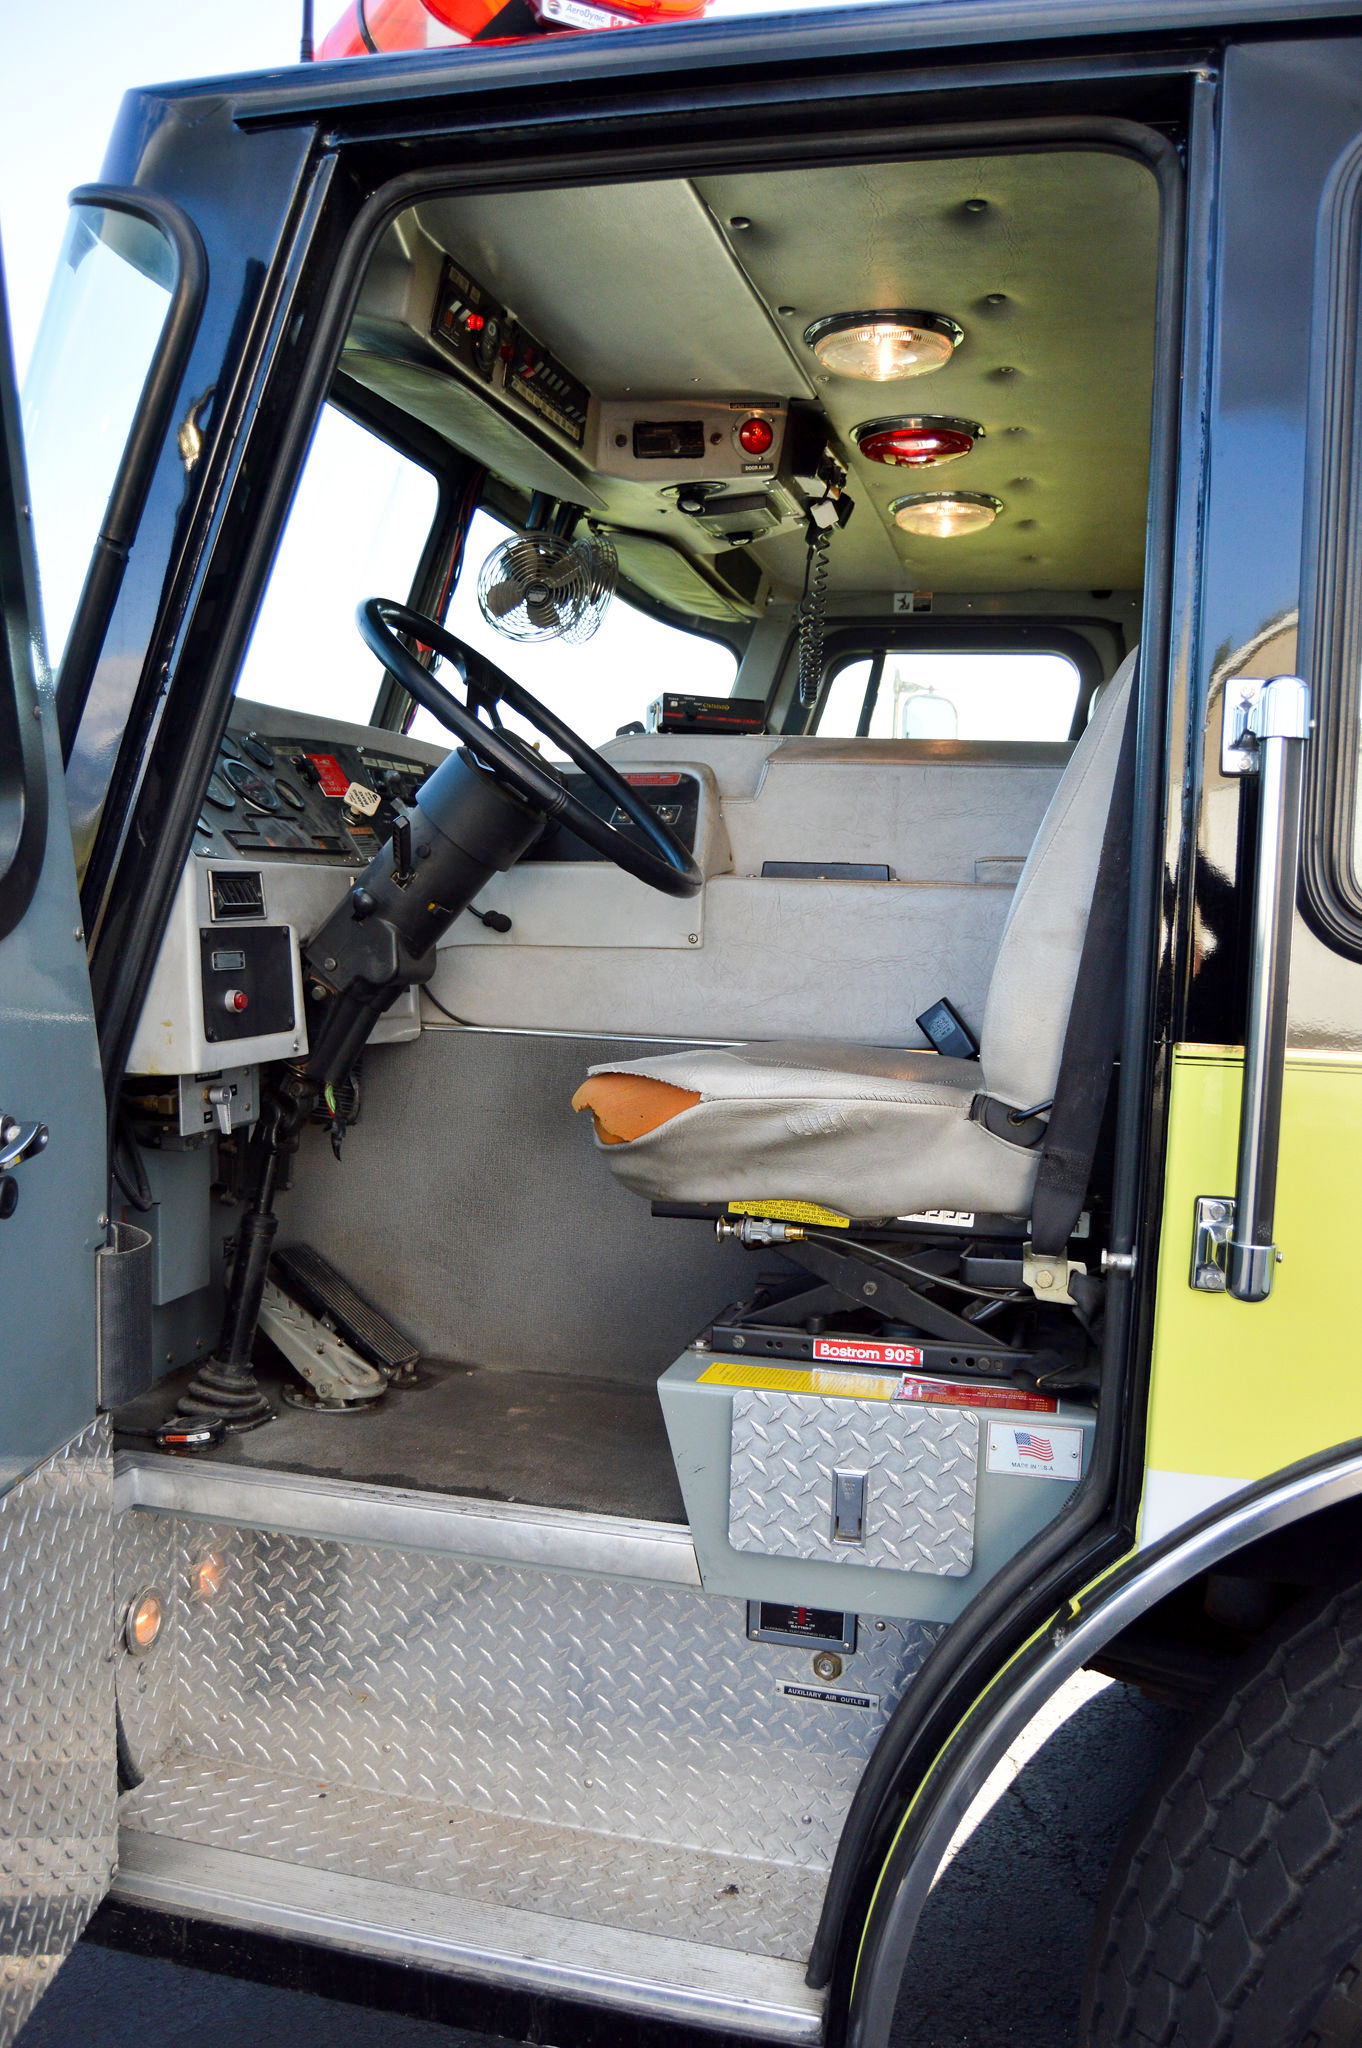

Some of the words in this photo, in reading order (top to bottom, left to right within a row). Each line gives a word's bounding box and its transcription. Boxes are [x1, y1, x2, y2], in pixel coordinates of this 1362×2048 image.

[566, 4, 605, 22] AeroDynic
[820, 1343, 880, 1359] Bostrom
[884, 1348, 915, 1362] 905
[788, 1688, 821, 1698] AUXILIARY
[825, 1693, 837, 1701] AIR
[841, 1697, 867, 1706] OUTLET
